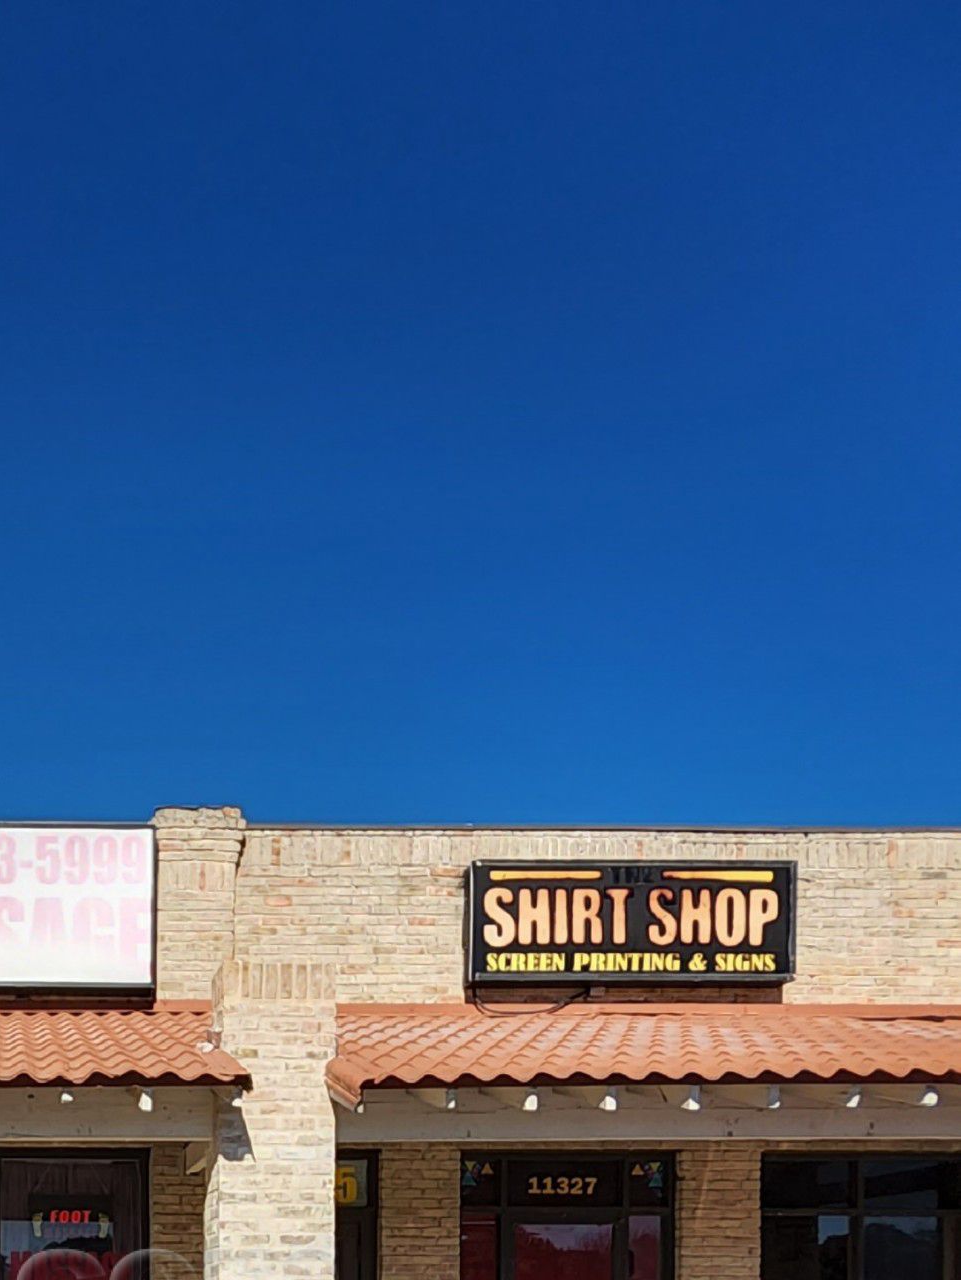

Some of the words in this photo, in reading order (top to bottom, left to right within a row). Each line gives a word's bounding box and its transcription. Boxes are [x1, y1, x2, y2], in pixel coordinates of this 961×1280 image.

[483, 888, 630, 948] SHIRT
[648, 888, 779, 948] SHOP
[486, 952, 566, 972] SCREEN
[572, 952, 681, 972] PRINTING
[688, 953, 708, 972] &
[715, 953, 776, 972] SIGNS
[527, 1176, 598, 1195] 11327
[49, 1210, 92, 1224] FOOT
